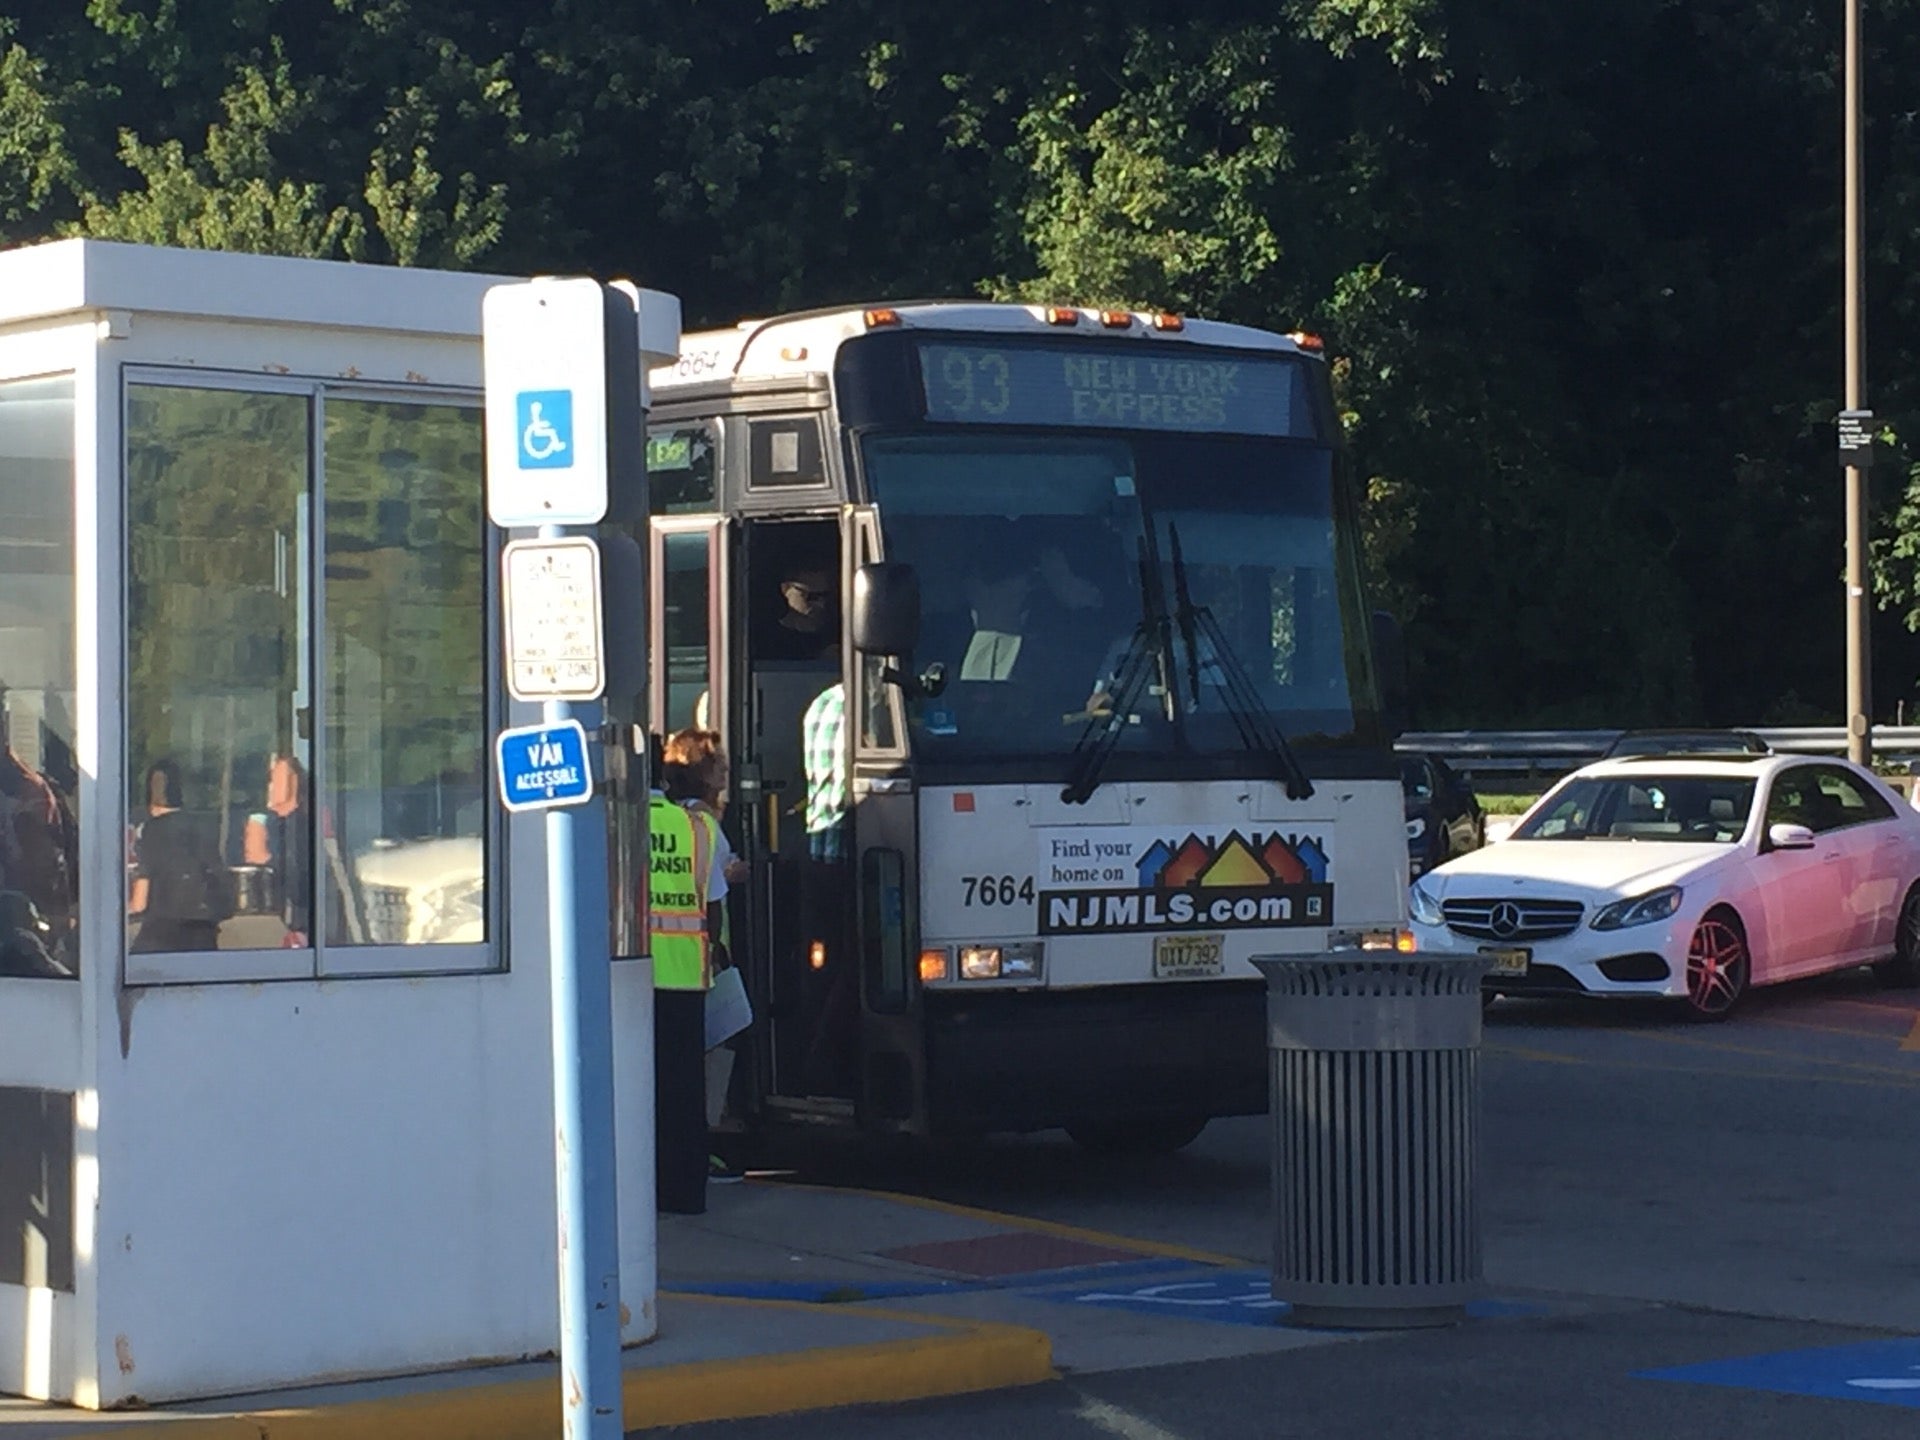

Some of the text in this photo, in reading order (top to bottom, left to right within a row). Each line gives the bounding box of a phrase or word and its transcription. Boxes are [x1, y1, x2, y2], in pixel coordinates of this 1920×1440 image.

[943, 351, 1010, 415] 93
[1063, 356, 1240, 394] NEW YORK
[1072, 390, 1227, 425] EXPRESS
[527, 742, 565, 768] VAN
[1051, 838, 1133, 862] Find your
[1051, 864, 1125, 882] home on
[961, 875, 1035, 907] 7664
[1049, 892, 1293, 928] NJMLS.com
